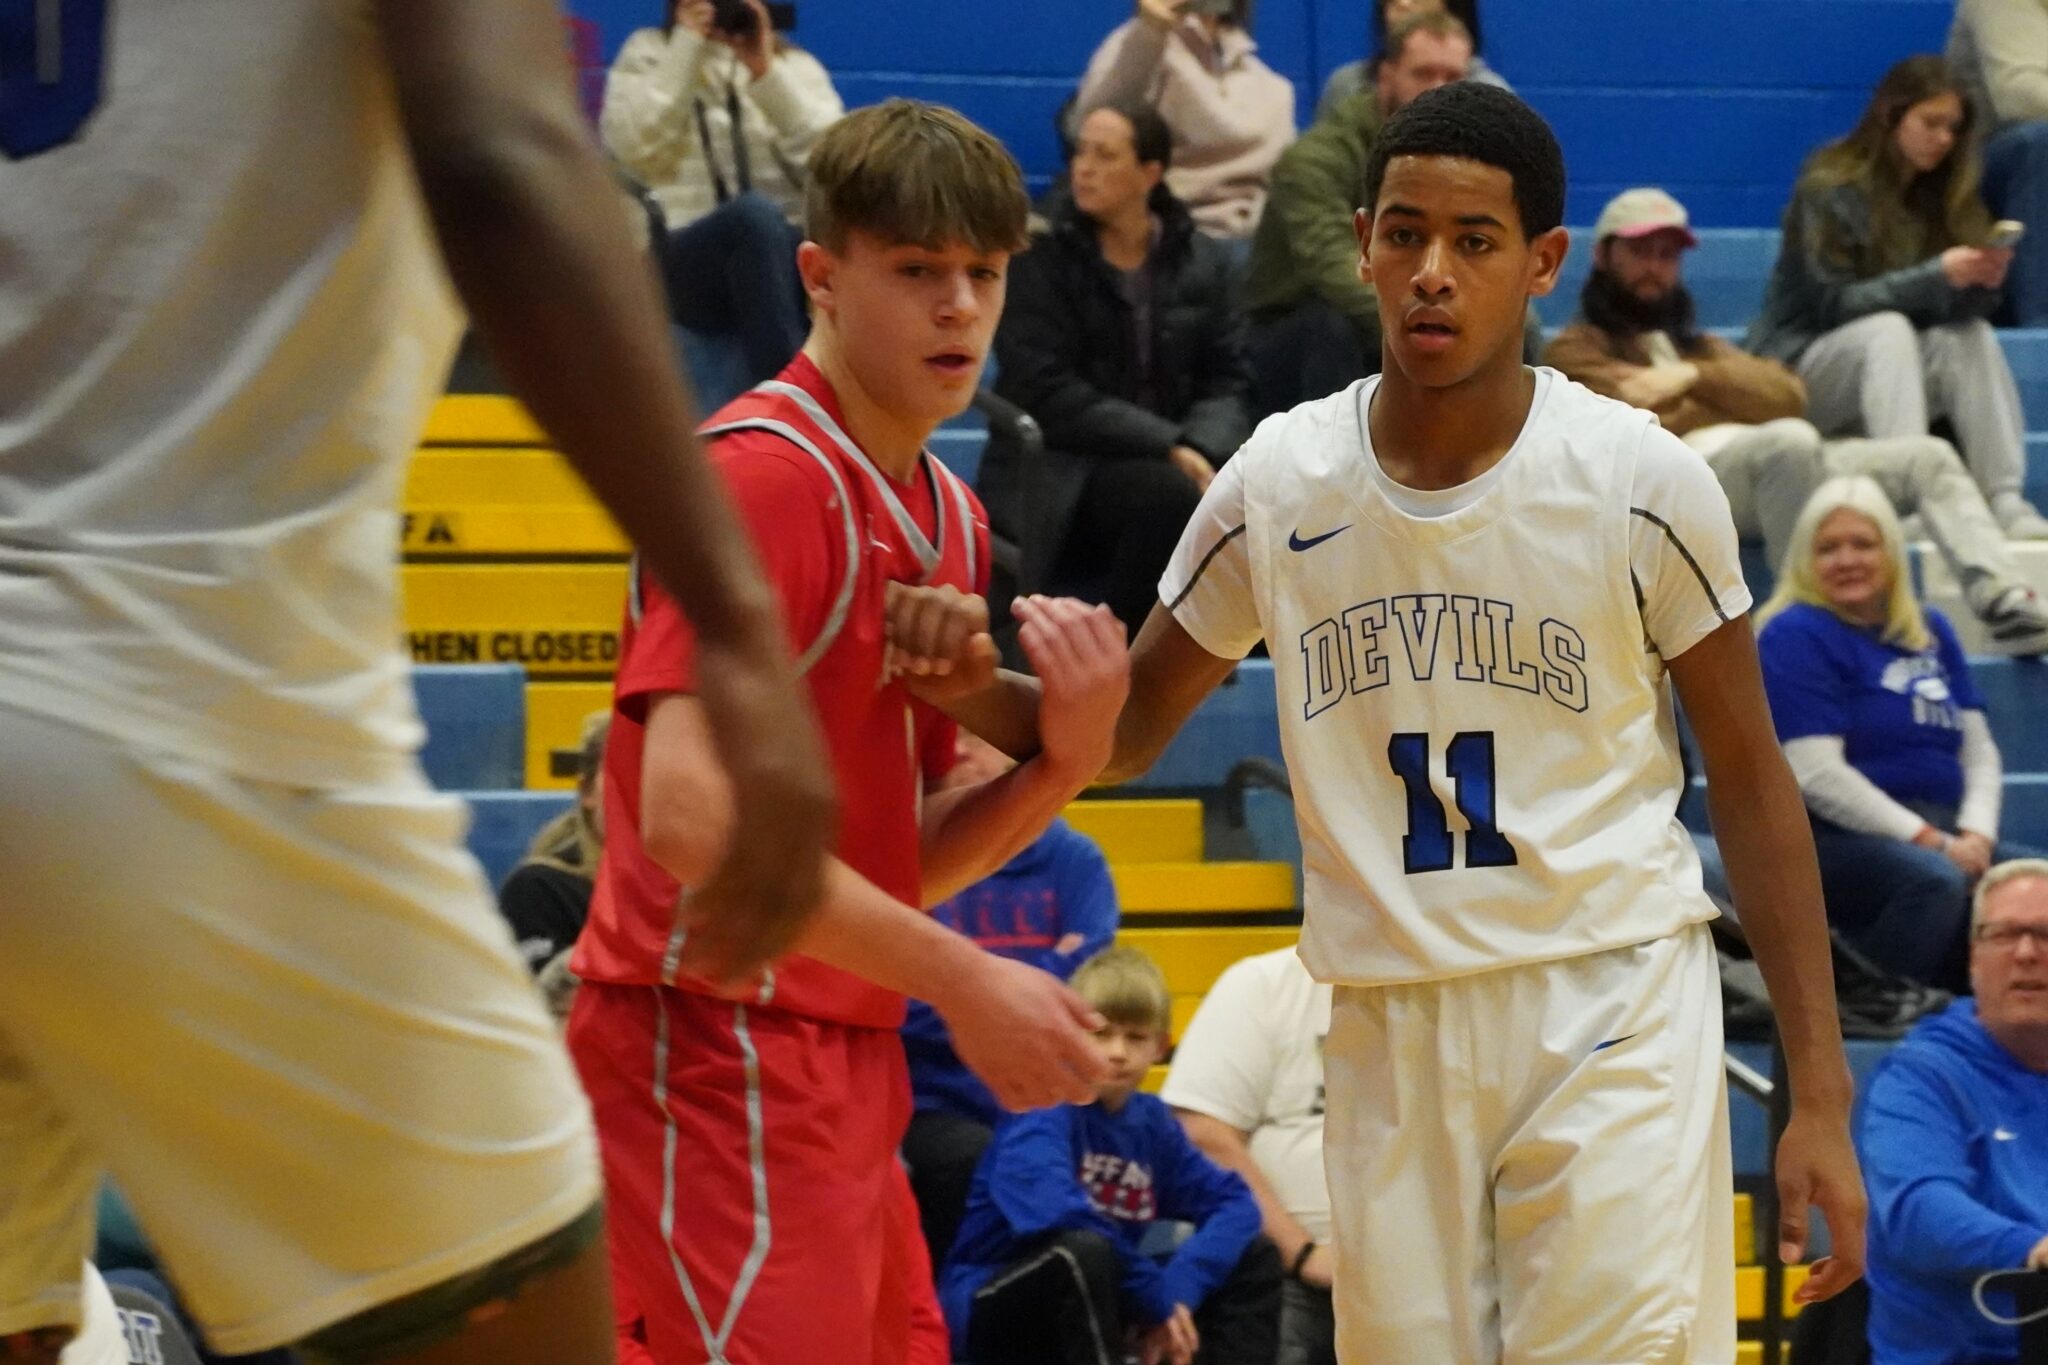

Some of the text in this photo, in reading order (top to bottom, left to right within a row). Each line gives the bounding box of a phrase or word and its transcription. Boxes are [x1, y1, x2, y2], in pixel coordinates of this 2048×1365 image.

[425, 515, 454, 543] A
[491, 632, 618, 662] CLOSED
[1300, 593, 1589, 721] DEVILS
[1387, 730, 1518, 874] 11
